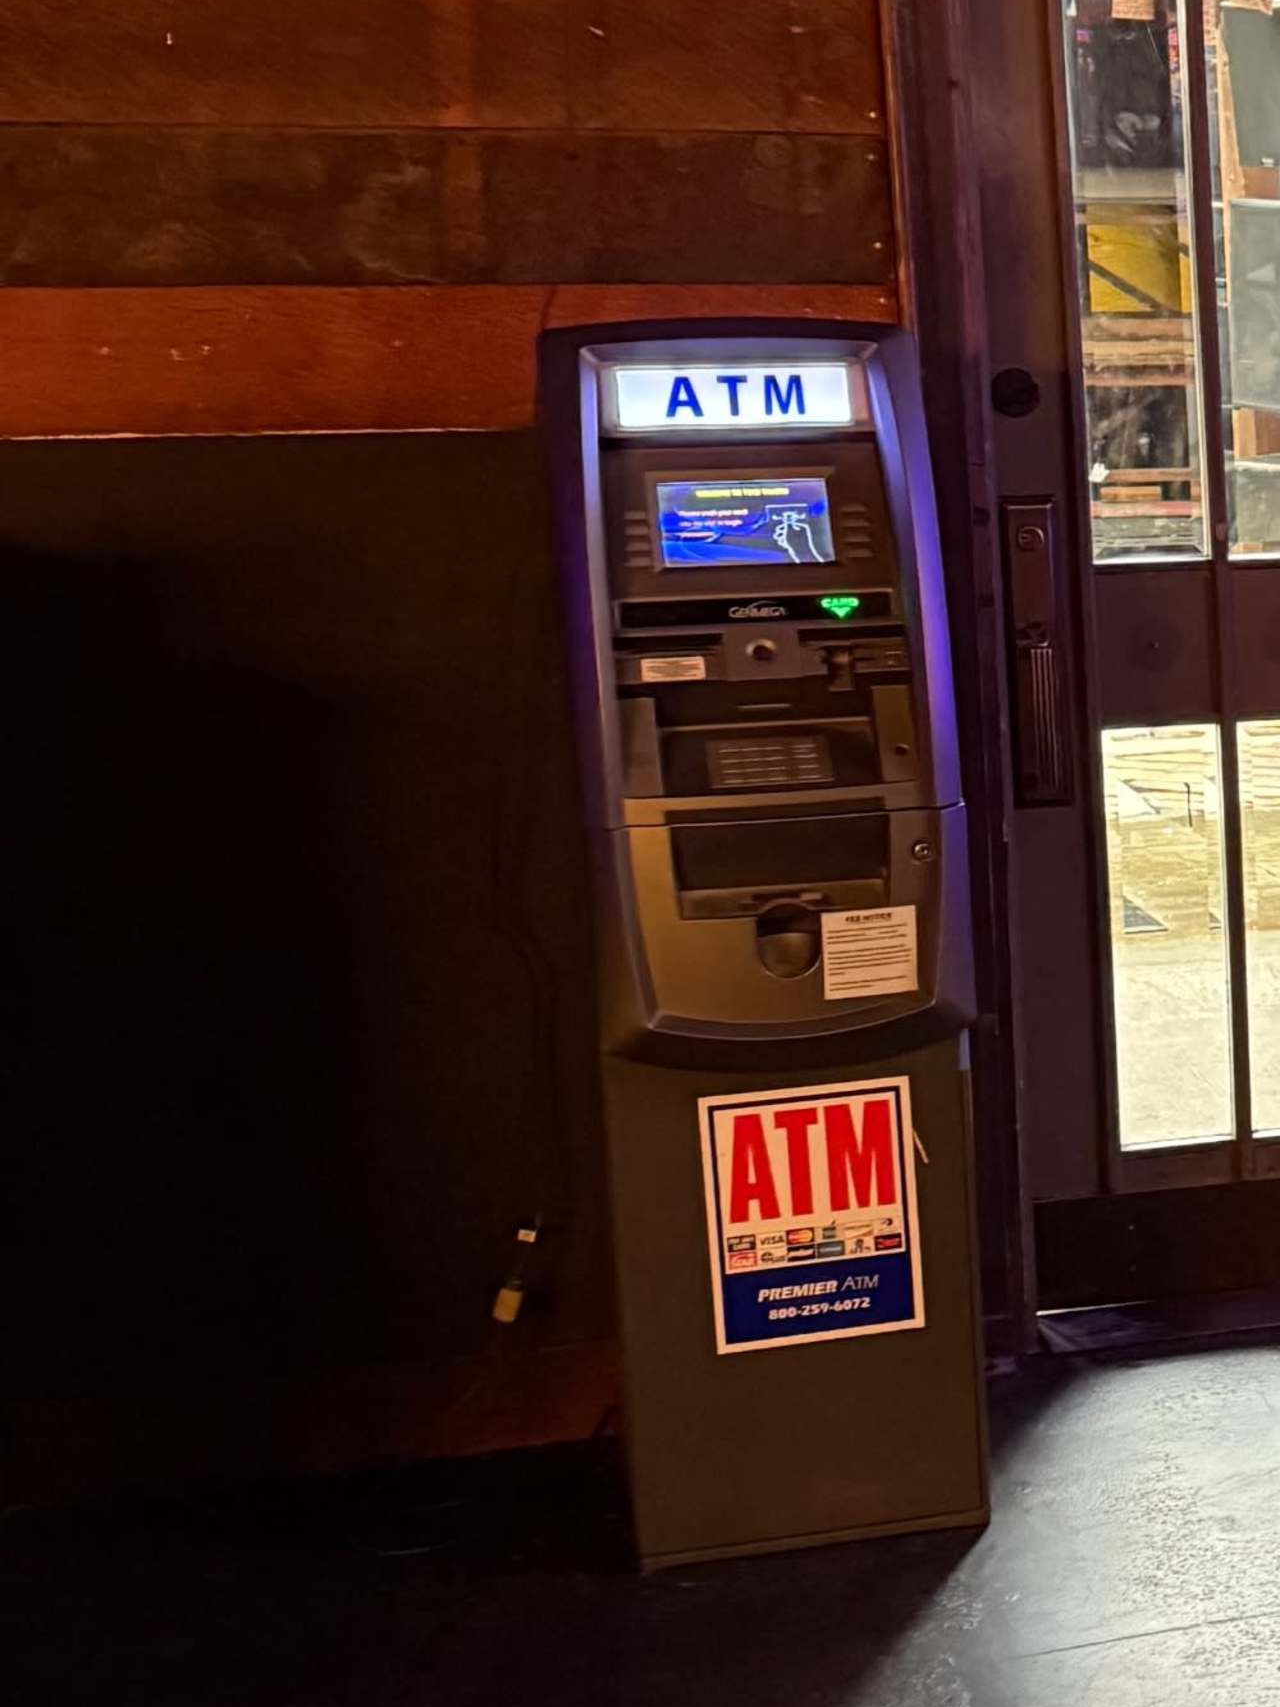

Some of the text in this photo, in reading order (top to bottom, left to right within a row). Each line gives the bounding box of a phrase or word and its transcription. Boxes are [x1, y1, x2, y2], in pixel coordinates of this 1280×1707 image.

[665, 374, 807, 418] ATM
[820, 596, 860, 609] CARD
[728, 1098, 897, 1224] ATM
[757, 1273, 880, 1303] PREMIER ATM
[768, 1296, 872, 1321] 800-259-6072
